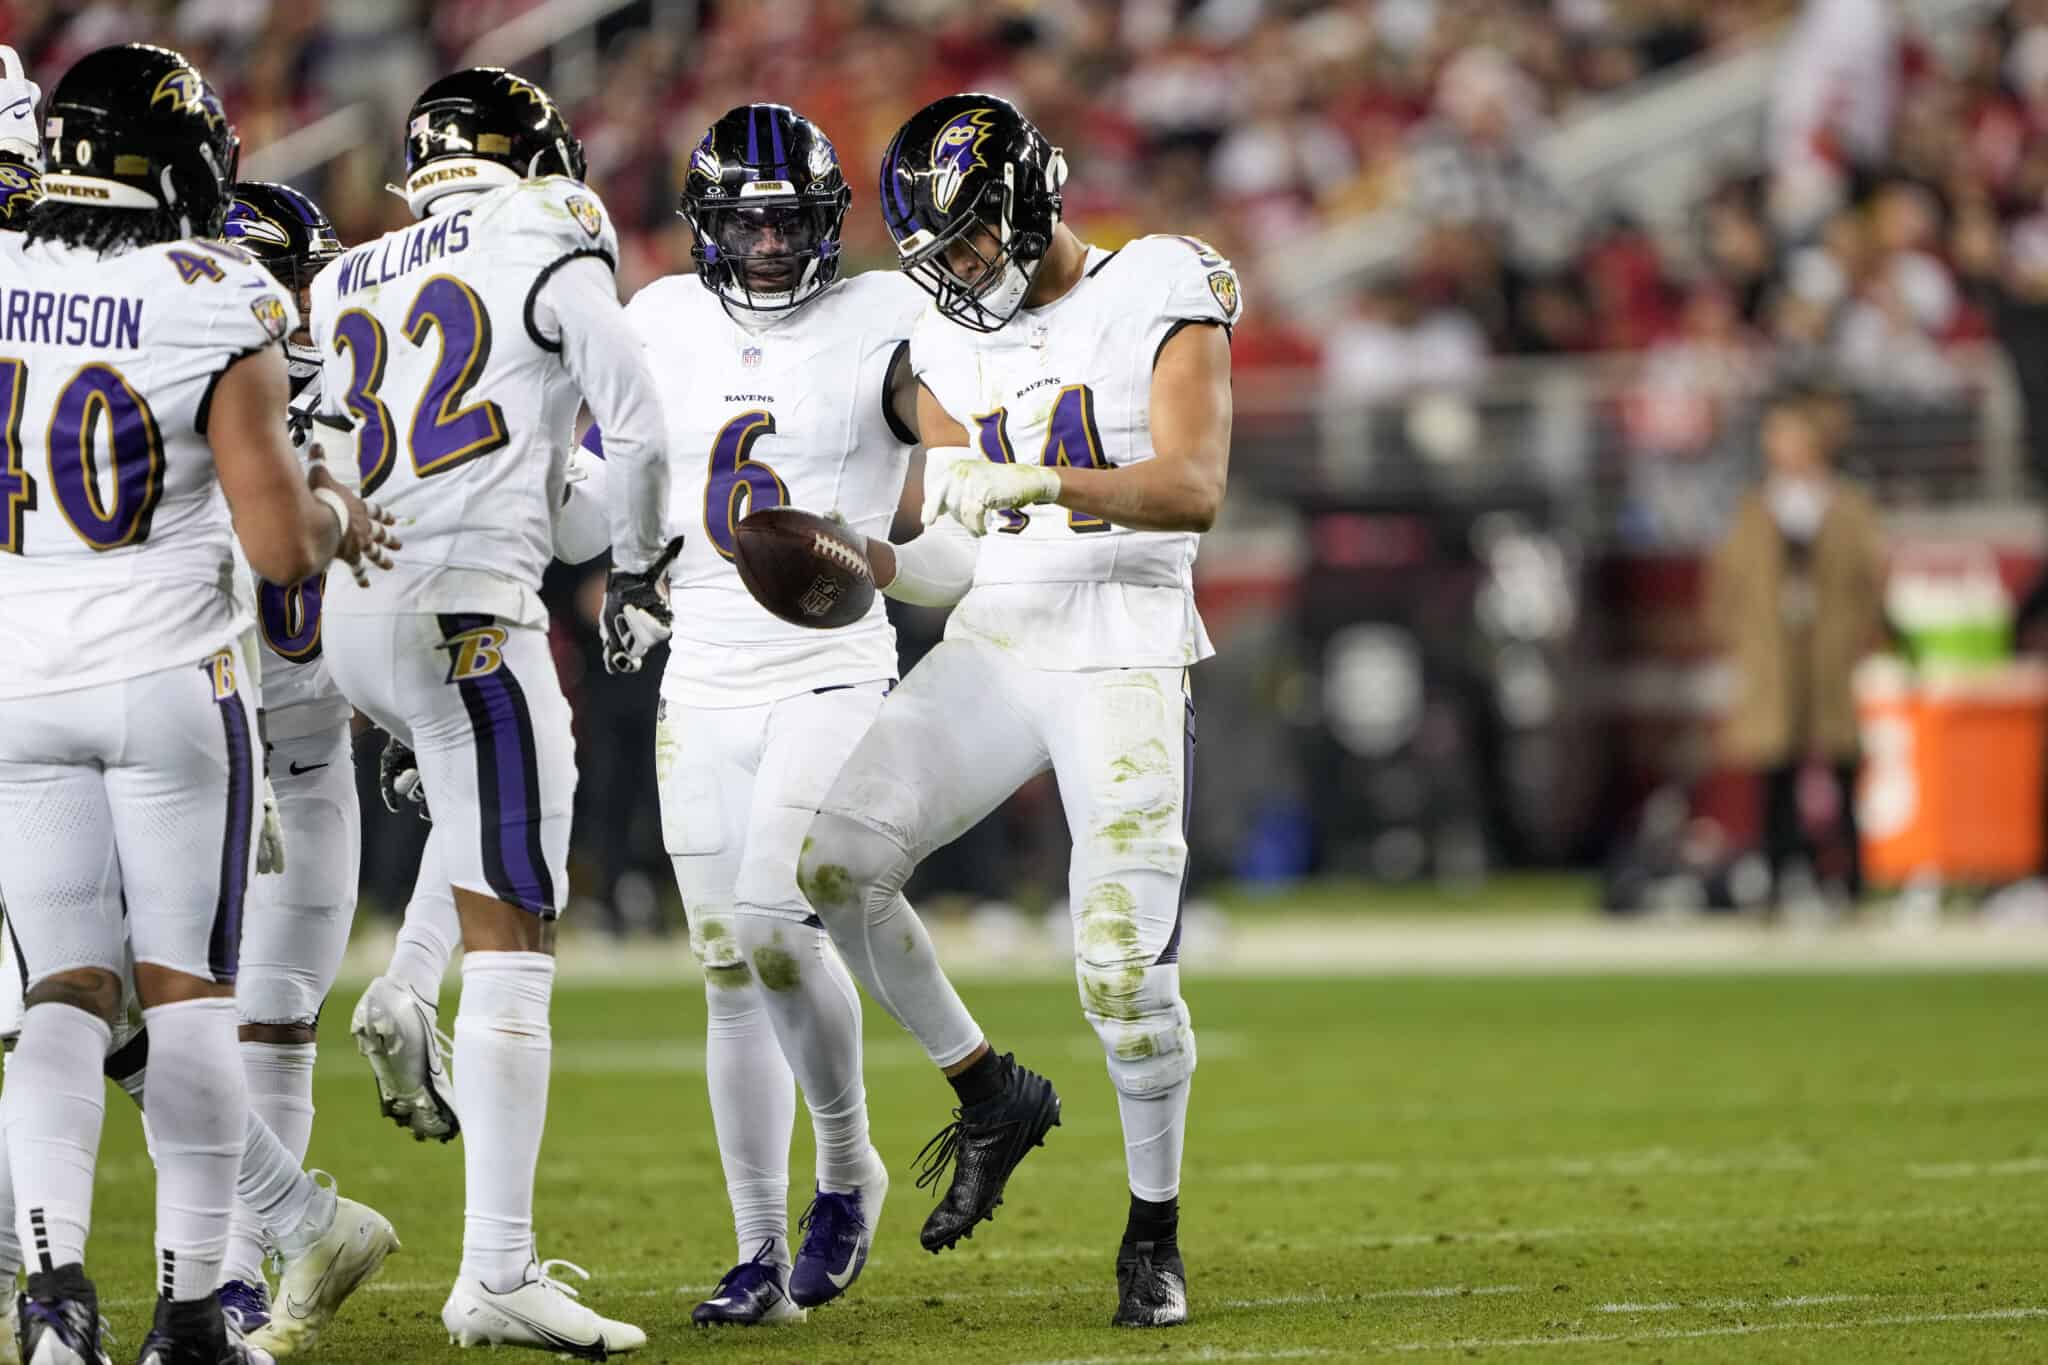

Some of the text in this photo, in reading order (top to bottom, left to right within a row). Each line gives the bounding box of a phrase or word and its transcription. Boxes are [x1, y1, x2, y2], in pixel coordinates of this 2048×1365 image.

[337, 209, 473, 301] WILLIAMS
[0, 287, 143, 350] RRISON
[333, 273, 510, 499] 32
[724, 394, 775, 403] RAVENS
[1016, 376, 1061, 399] RAVENS
[703, 408, 791, 565] 6
[203, 647, 237, 701] B
[446, 626, 508, 684] B
